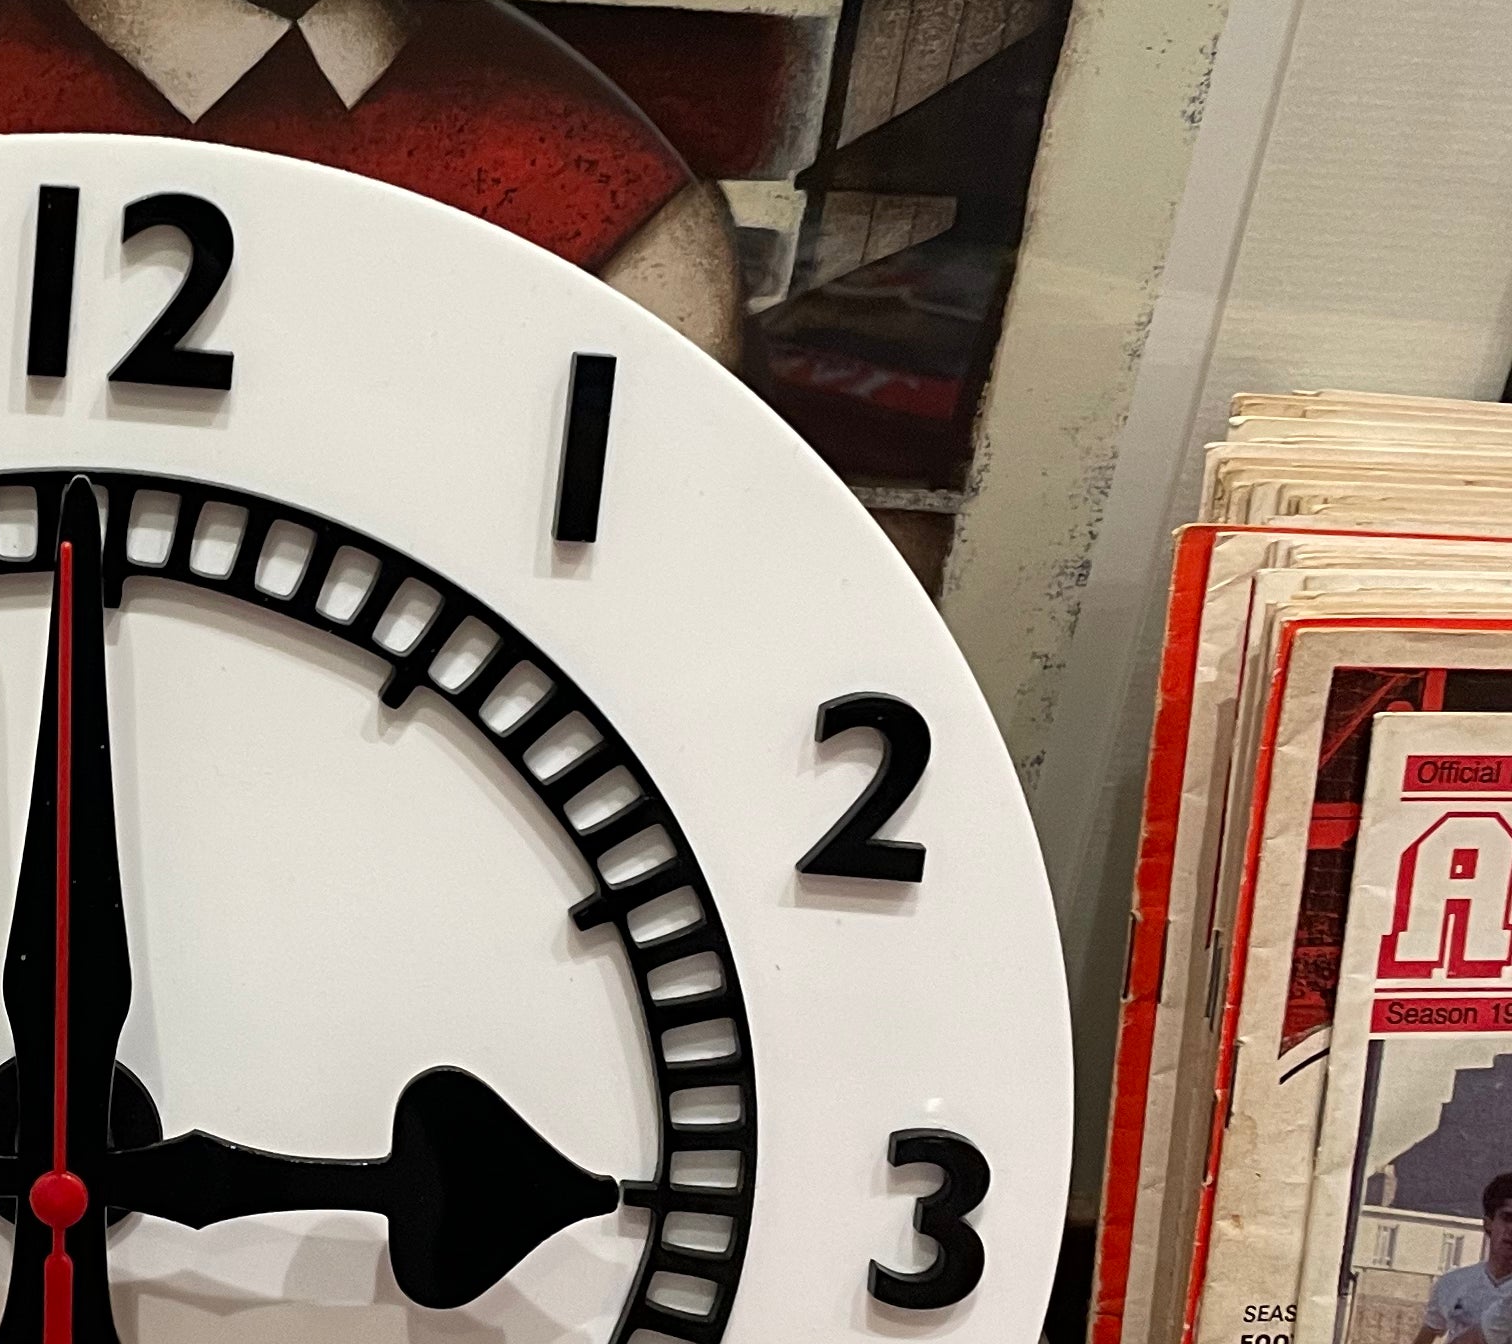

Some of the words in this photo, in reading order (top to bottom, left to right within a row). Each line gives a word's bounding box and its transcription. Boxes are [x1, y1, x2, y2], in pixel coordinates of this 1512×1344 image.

[26, 183, 236, 391] 12
[551, 351, 617, 543] 1
[794, 690, 933, 884] 2
[1417, 760, 1502, 785] Official
[1377, 811, 1512, 979] A
[1385, 1002, 1478, 1026] Season
[867, 1127, 991, 1311] 3
